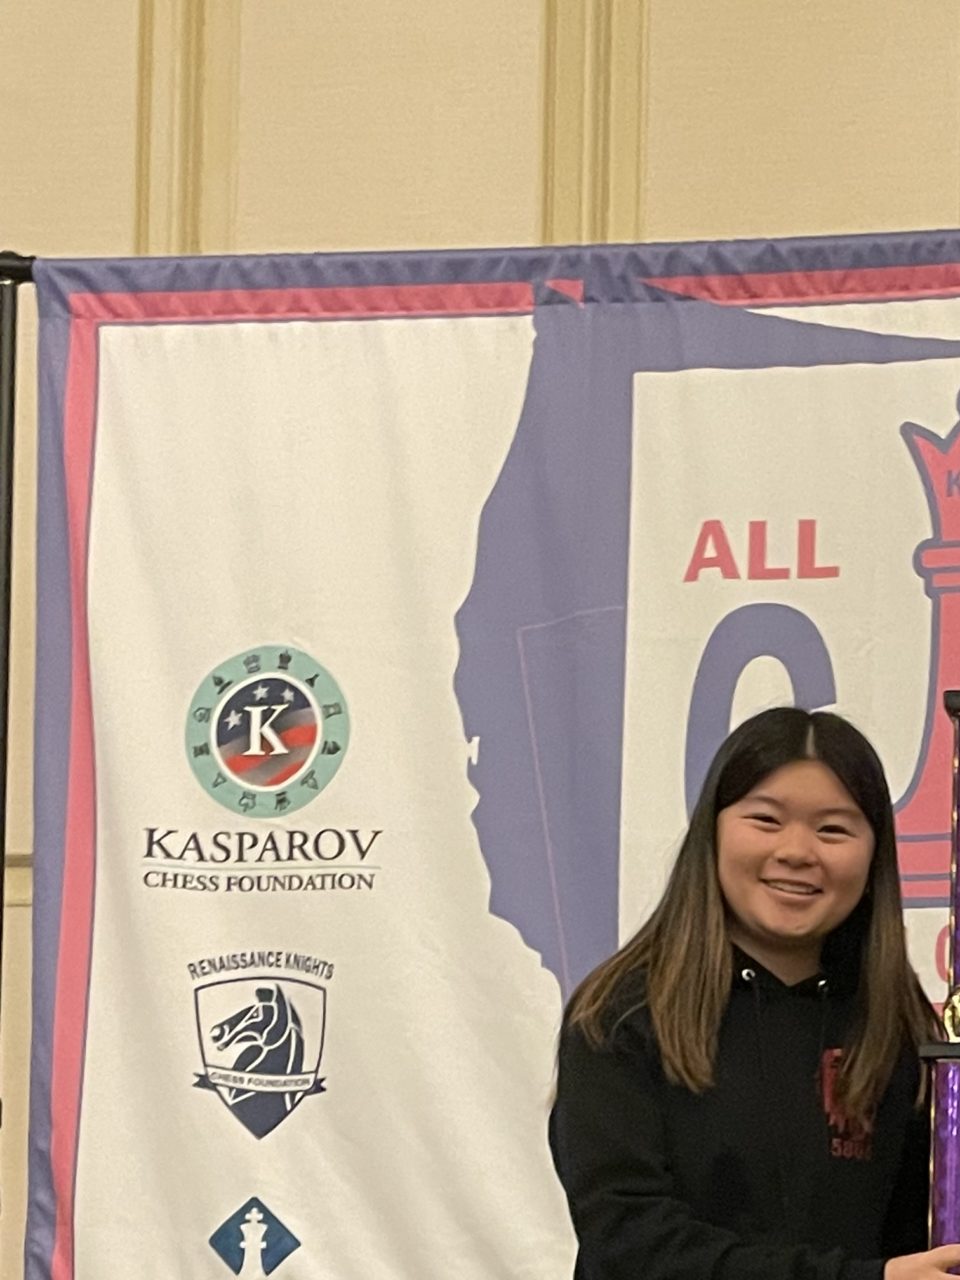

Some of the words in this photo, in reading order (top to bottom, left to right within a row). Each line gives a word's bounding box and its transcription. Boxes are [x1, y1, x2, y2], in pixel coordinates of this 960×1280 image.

[683, 519, 840, 582] ALL
[241, 703, 290, 756] K
[143, 827, 383, 863] KASPAROV
[143, 871, 219, 892] CHESS
[225, 873, 375, 892] FOUNDATION
[187, 951, 283, 980] RENAISSANCE
[284, 952, 335, 980] KNIGHTS
[210, 1071, 245, 1085] CHESS
[247, 1076, 311, 1088] FOUNDATION
